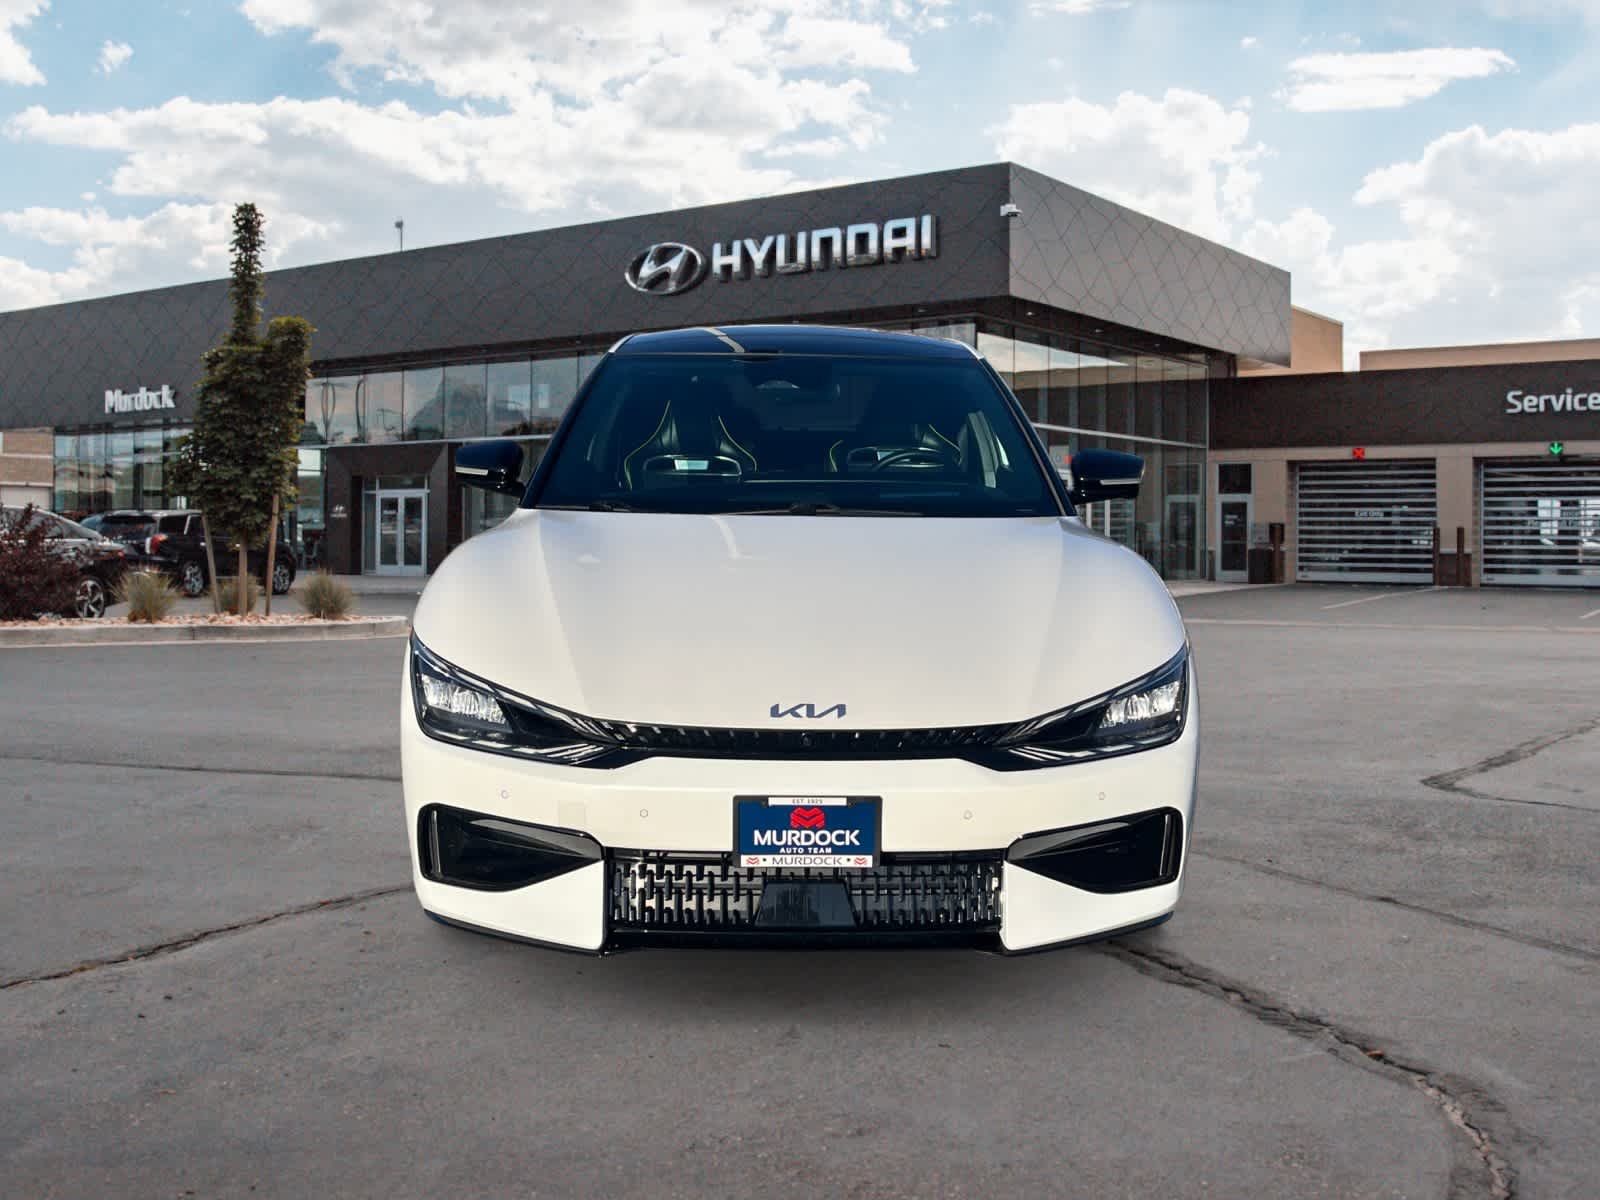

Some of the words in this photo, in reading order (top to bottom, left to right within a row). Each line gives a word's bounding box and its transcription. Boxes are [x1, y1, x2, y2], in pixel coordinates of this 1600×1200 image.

[712, 214, 936, 281] HYUNDAI
[104, 384, 176, 414] Murdock
[1505, 387, 1600, 414] Service
[770, 703, 846, 718] KIA
[753, 829, 860, 846] MURDOCK
[772, 856, 842, 865] MURDOCK
